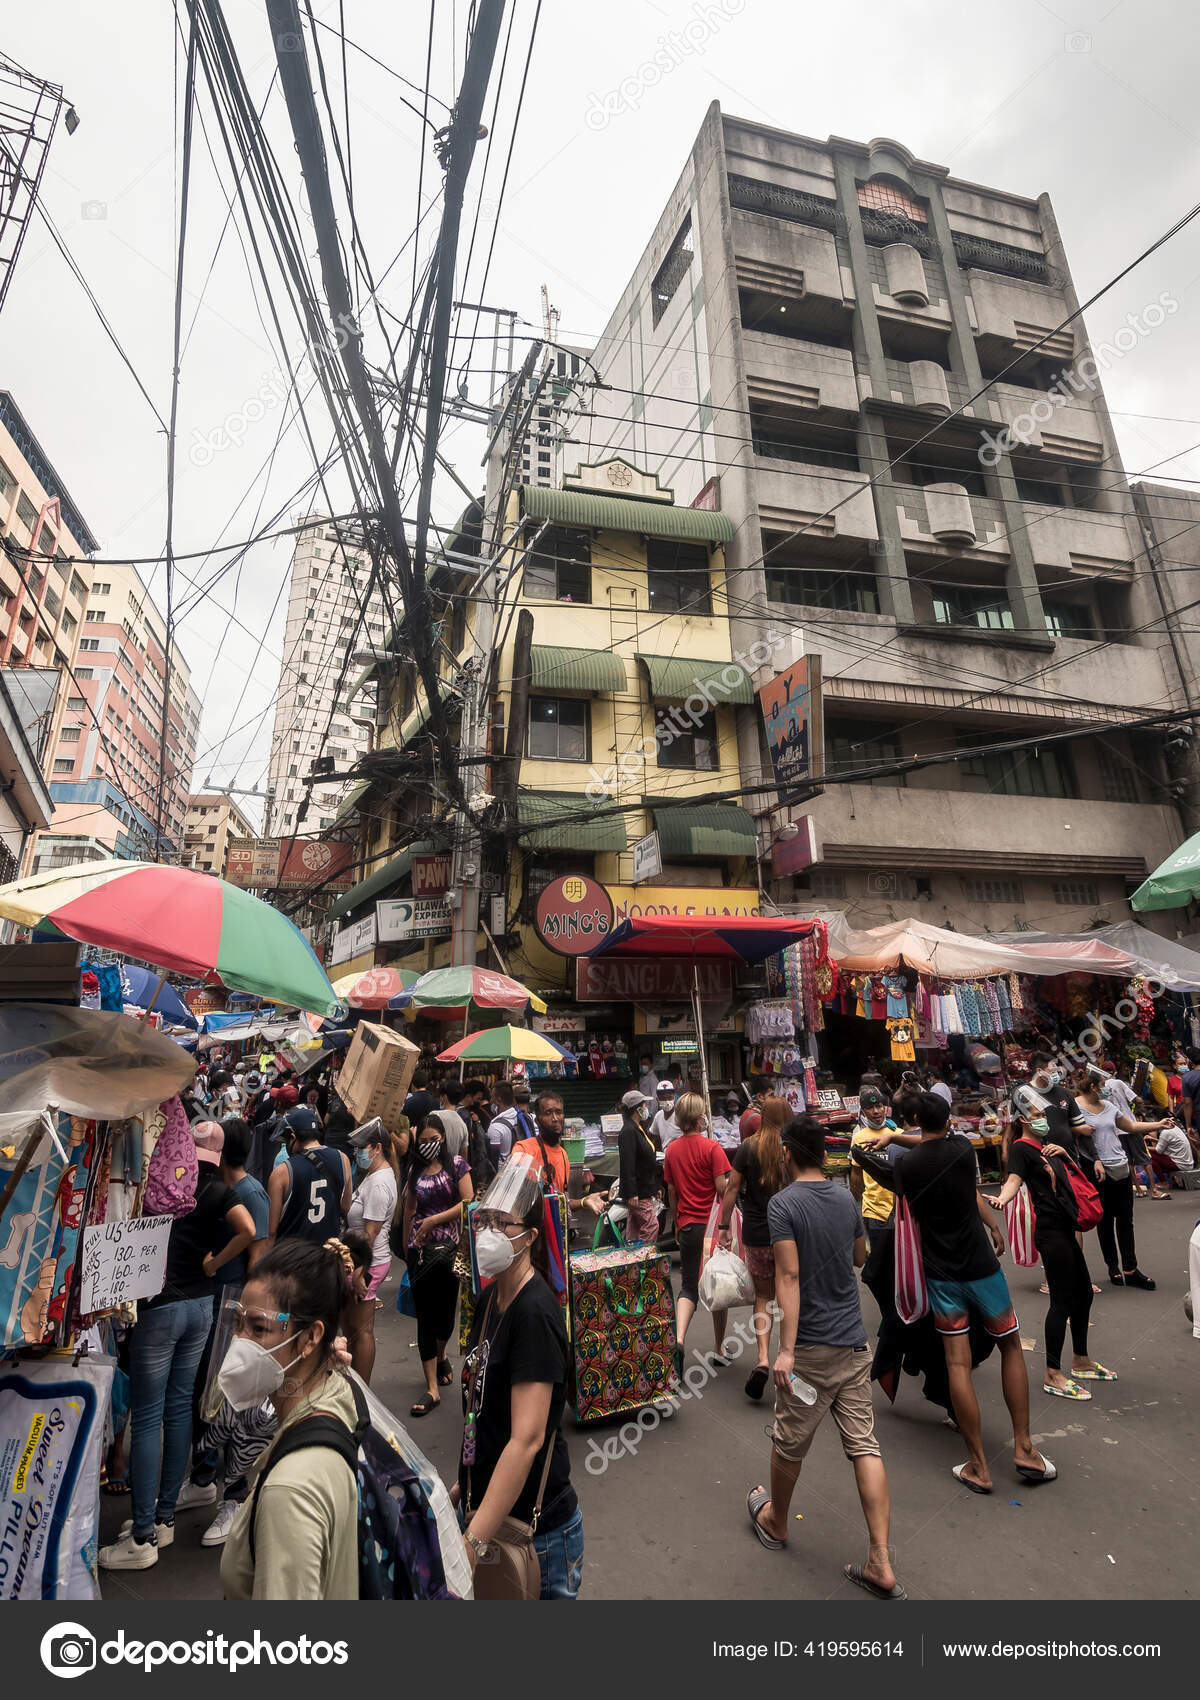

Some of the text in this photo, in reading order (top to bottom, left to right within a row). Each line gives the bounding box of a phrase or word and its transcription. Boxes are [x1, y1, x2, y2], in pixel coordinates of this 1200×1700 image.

[565, 881, 583, 899] 明
[542, 909, 610, 940] MING'S
[586, 962, 722, 995] SANGLAAN
[543, 1022, 579, 1030] PLAY
[818, 1091, 836, 1101] REF
[307, 1179, 327, 1224] 5
[105, 1216, 173, 1243] US CANADIAN
[140, 1244, 158, 1257] PER
[33, 1407, 66, 1486] Sweet
[53, 1458, 63, 1480] IT'S
[45, 1482, 57, 1509] SOFT
[39, 1510, 50, 1532] BUY
